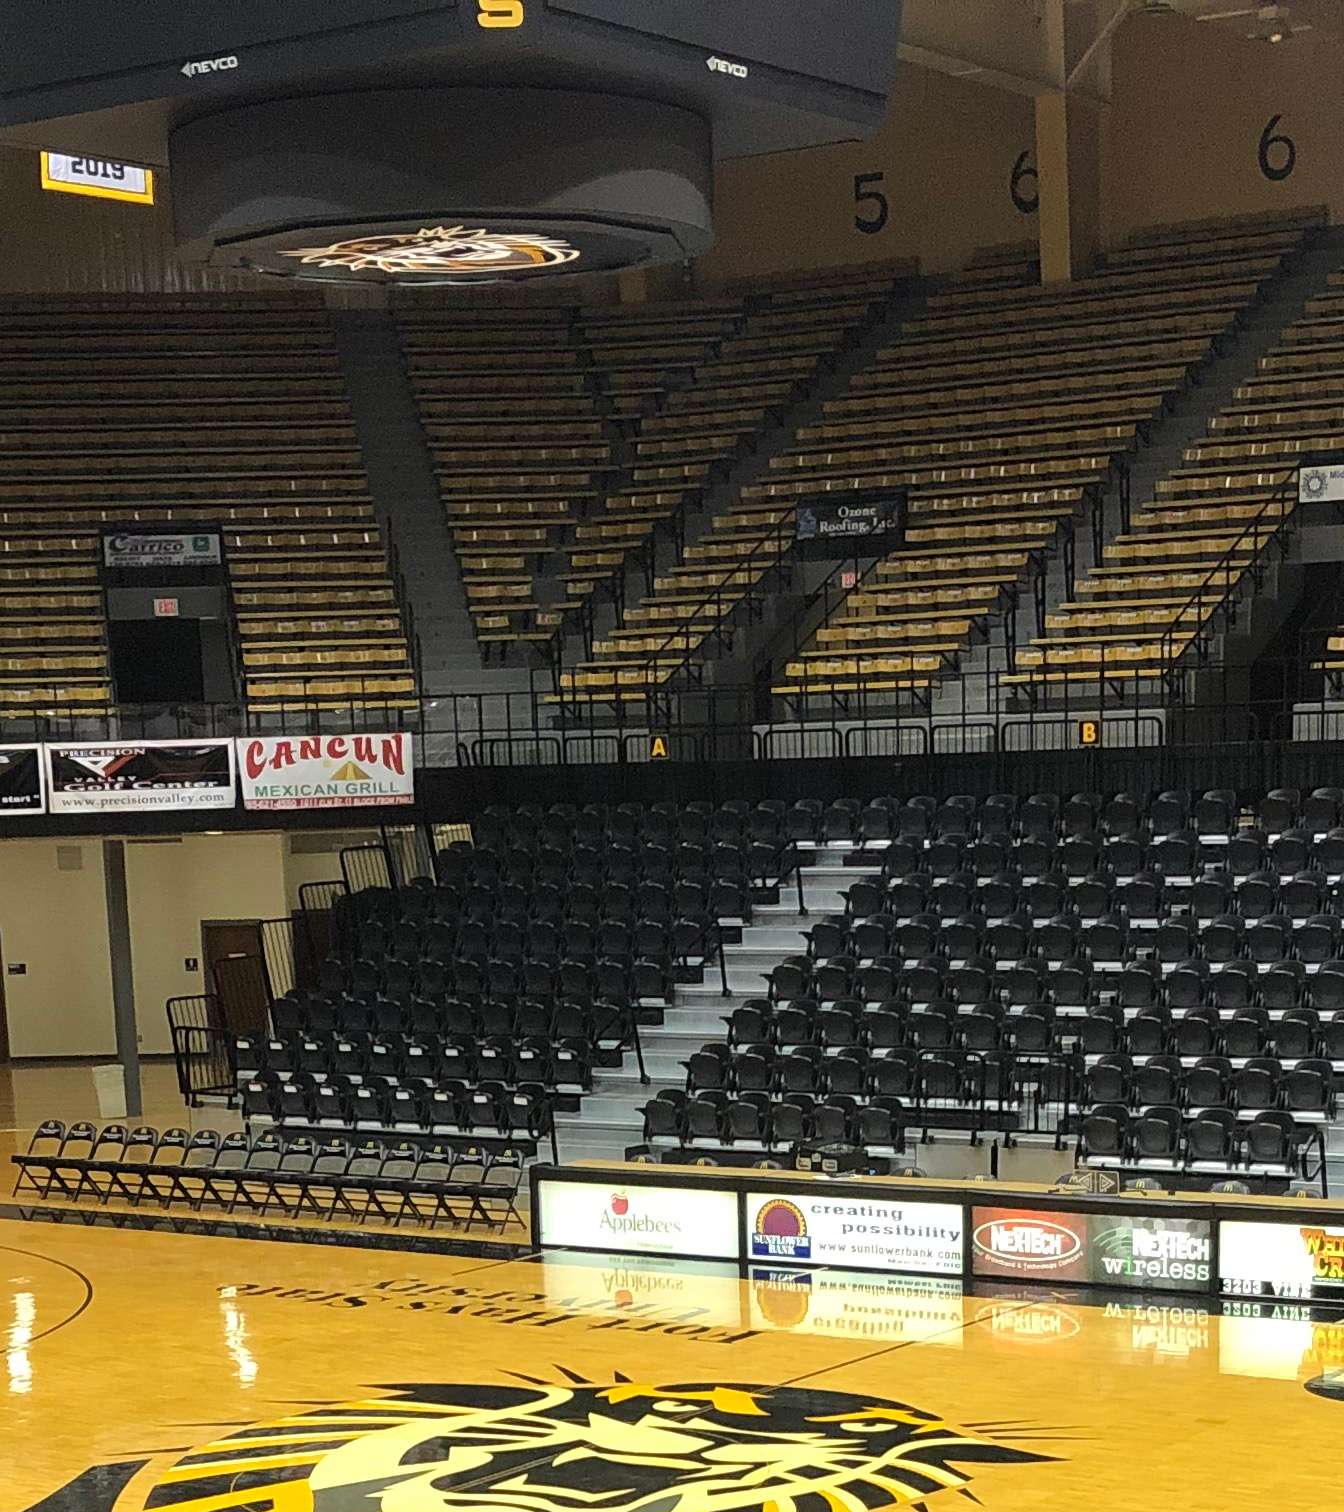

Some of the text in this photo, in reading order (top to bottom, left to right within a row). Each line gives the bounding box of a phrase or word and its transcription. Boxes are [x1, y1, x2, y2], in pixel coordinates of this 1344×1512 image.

[1259, 114, 1296, 181] 6
[1010, 150, 1039, 215] 6
[854, 172, 888, 234] 5
[838, 506, 876, 518] Ozone
[1082, 722, 1095, 743] B
[59, 747, 145, 758] PRECISION
[246, 734, 406, 780] CANCUN
[651, 737, 665, 757] A
[63, 780, 218, 792] Golf Center
[255, 781, 400, 798] MEXICAN GRILL
[811, 1204, 903, 1221] creating
[754, 1234, 809, 1247] SUNFLOWER
[842, 1222, 960, 1242] possibility
[768, 1244, 795, 1255] BANK
[1102, 1257, 1209, 1281] wireless
[1222, 1278, 1262, 1294] 3203
[1272, 1281, 1311, 1298] VINE
[588, 1319, 760, 1344] Fort
